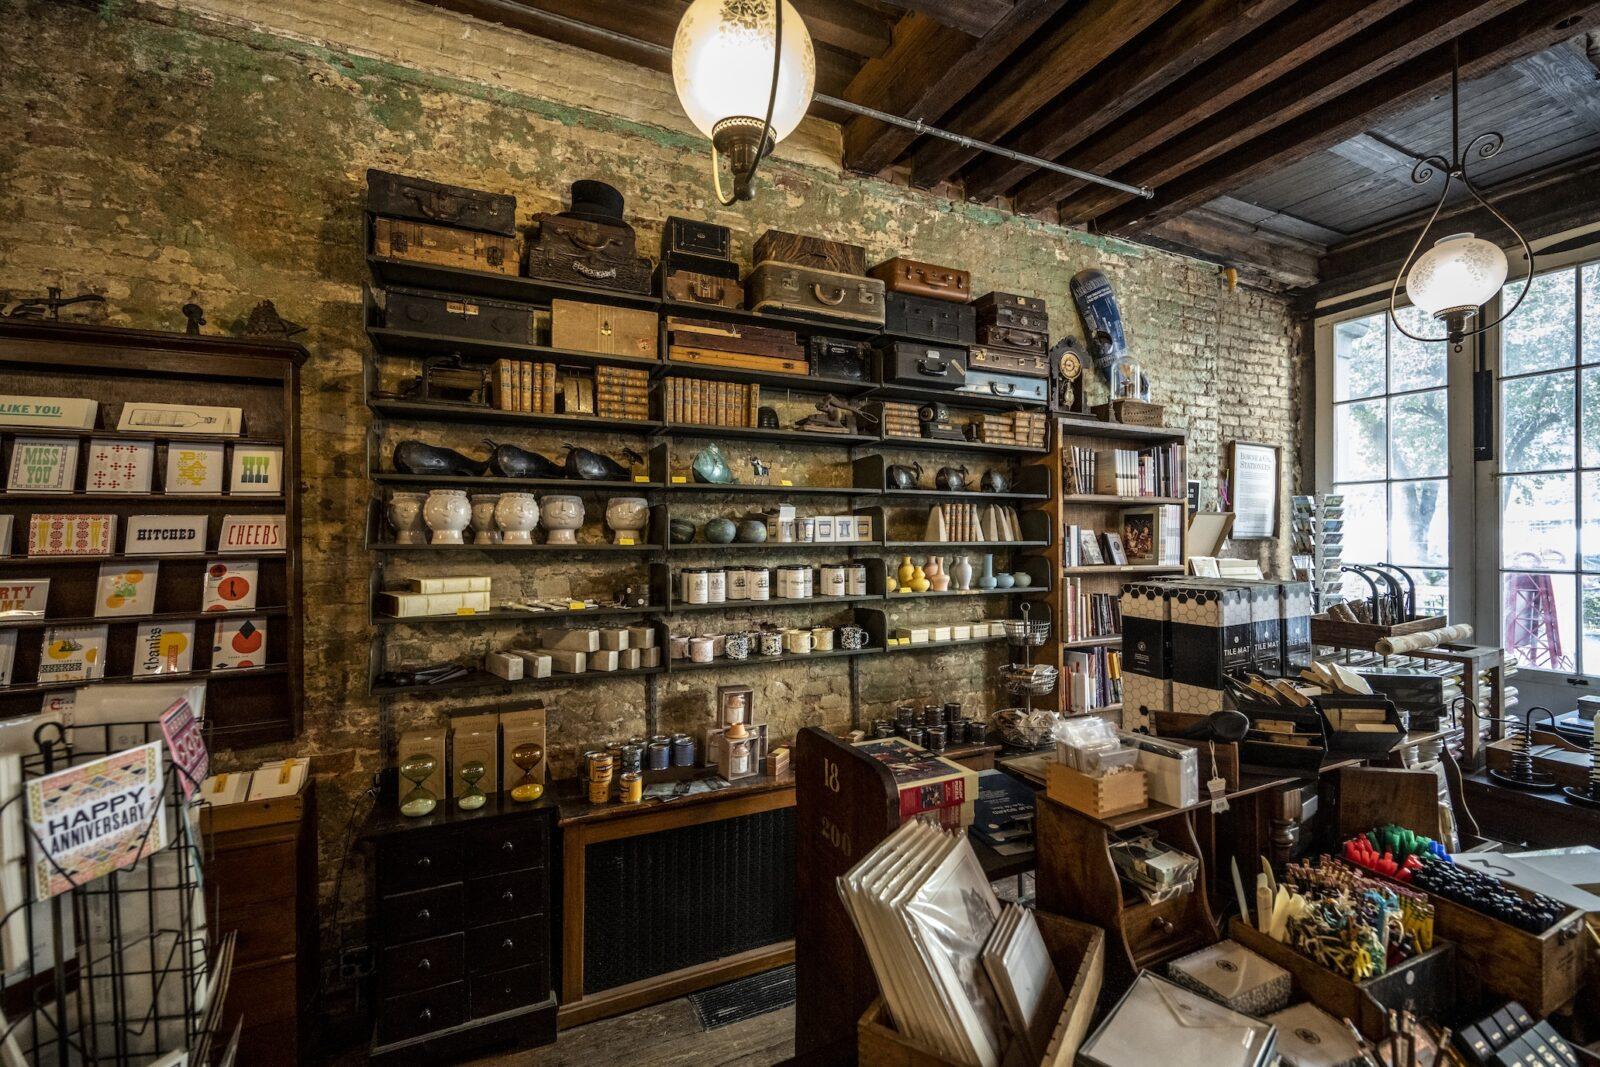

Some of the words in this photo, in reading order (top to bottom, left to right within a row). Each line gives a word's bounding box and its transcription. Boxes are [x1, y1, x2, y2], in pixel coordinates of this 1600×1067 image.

[0, 403, 31, 414] LIKE
[35, 404, 63, 415] YOU.
[25, 448, 58, 466] MISS
[27, 466, 52, 484] YOU
[137, 528, 196, 541] HITCHED
[227, 524, 279, 545] CHEERS
[143, 627, 162, 671] thanks
[1223, 647, 1237, 657] TILE
[1237, 645, 1250, 655] MAT
[1254, 642, 1266, 651] TILE
[1267, 640, 1279, 649] MAT
[823, 757, 841, 793] 18
[48, 786, 146, 836] HAPPY
[51, 802, 147, 855] ANNIVERSARY
